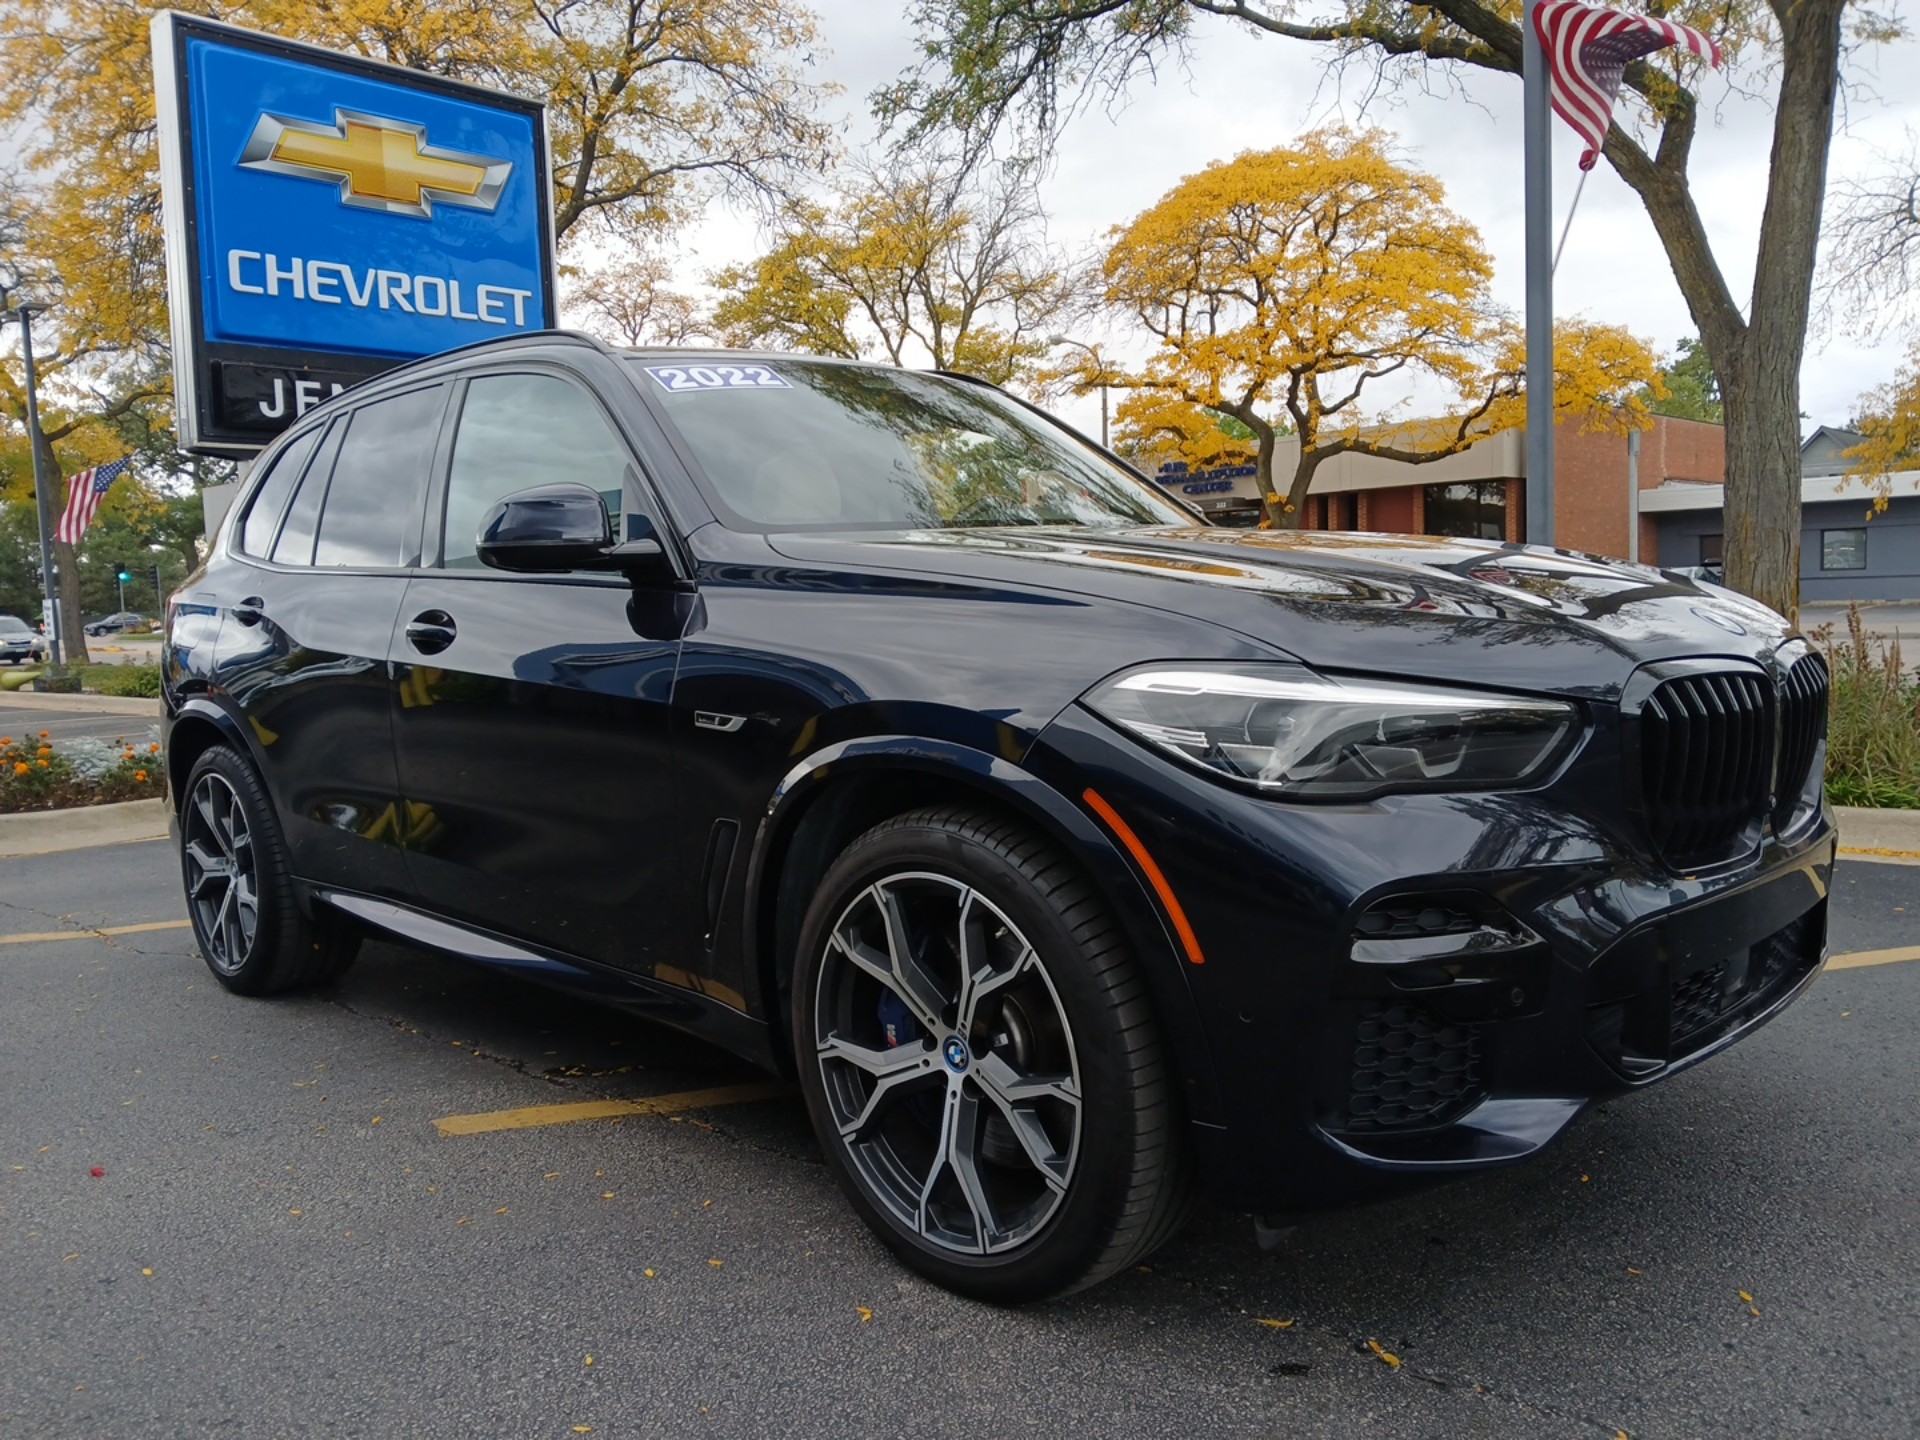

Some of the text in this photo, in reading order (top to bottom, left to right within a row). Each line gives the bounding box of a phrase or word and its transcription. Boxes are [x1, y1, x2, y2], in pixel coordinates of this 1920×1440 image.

[228, 249, 532, 326] CHEVROLET
[259, 378, 344, 418] JE
[658, 367, 783, 389] 2022
